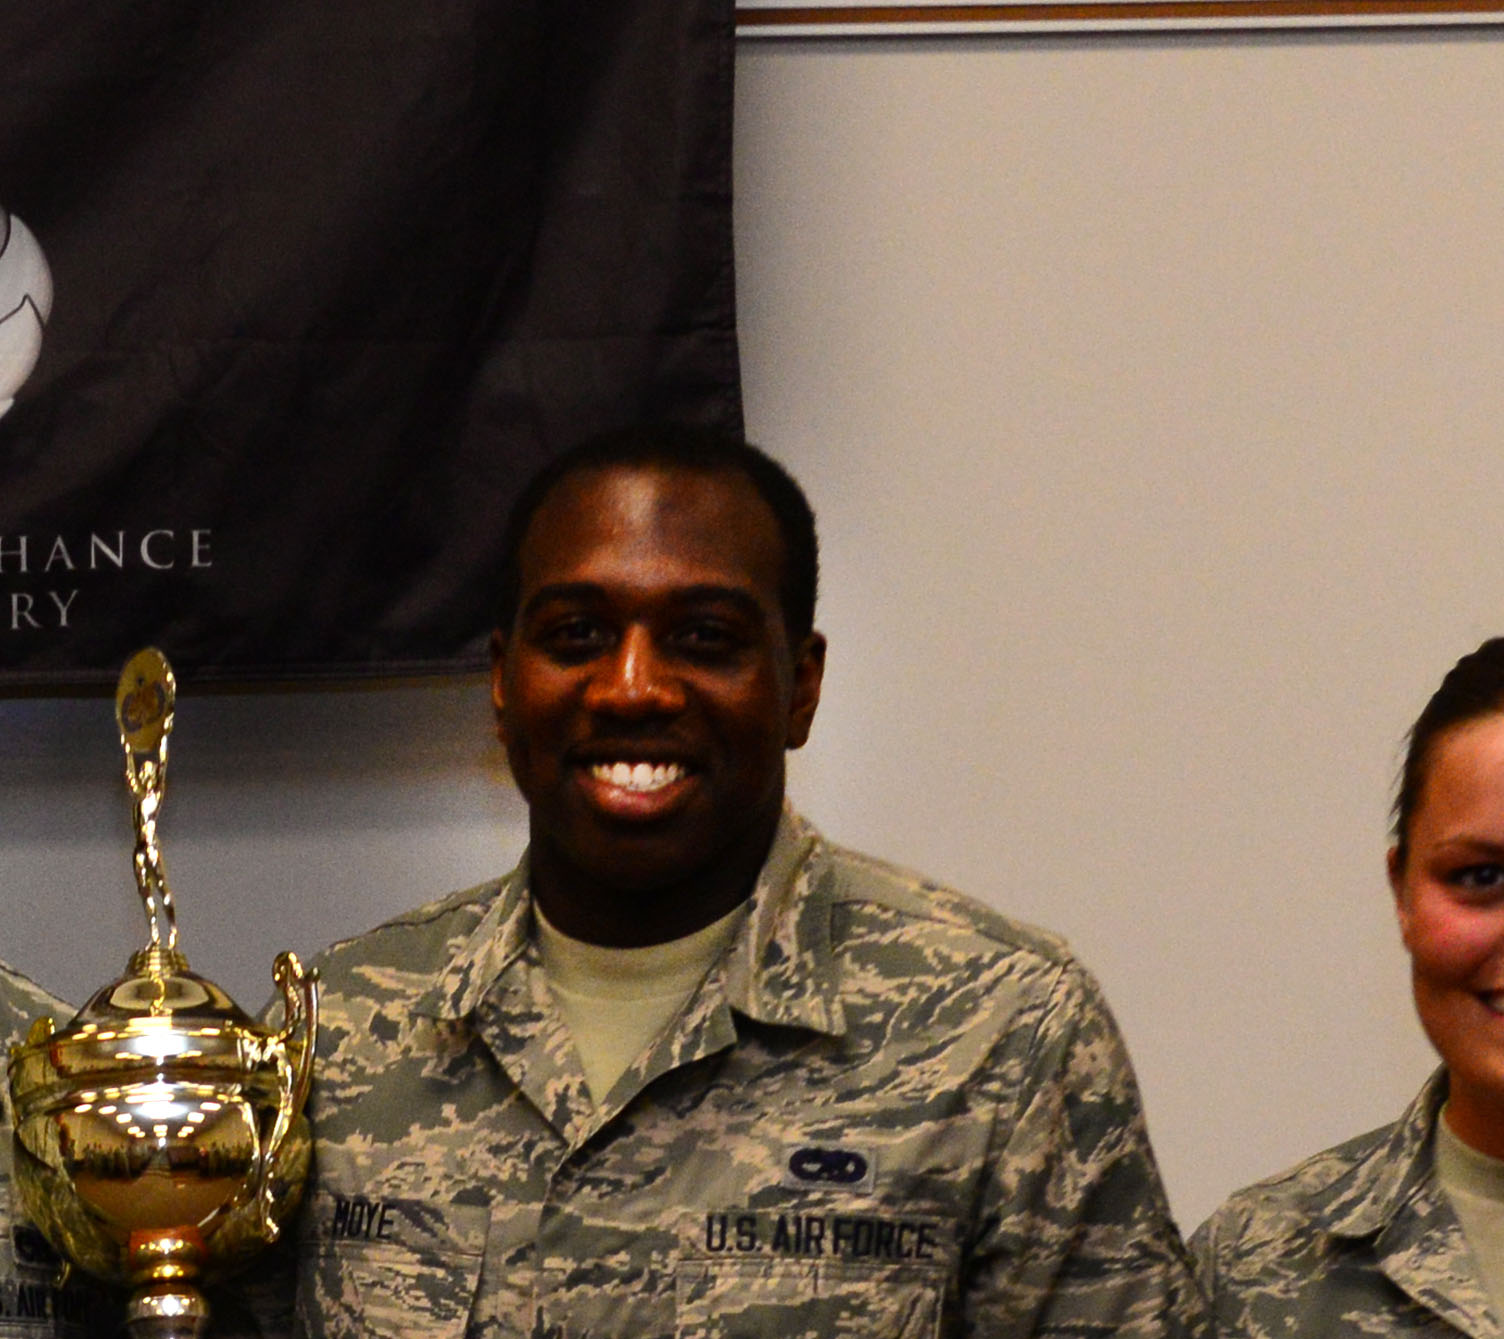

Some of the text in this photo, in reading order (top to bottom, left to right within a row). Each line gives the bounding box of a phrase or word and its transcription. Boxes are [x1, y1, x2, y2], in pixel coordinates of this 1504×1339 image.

[333, 1198, 394, 1240] MOYE
[706, 1214, 937, 1258] U.S. AIR FORCE
